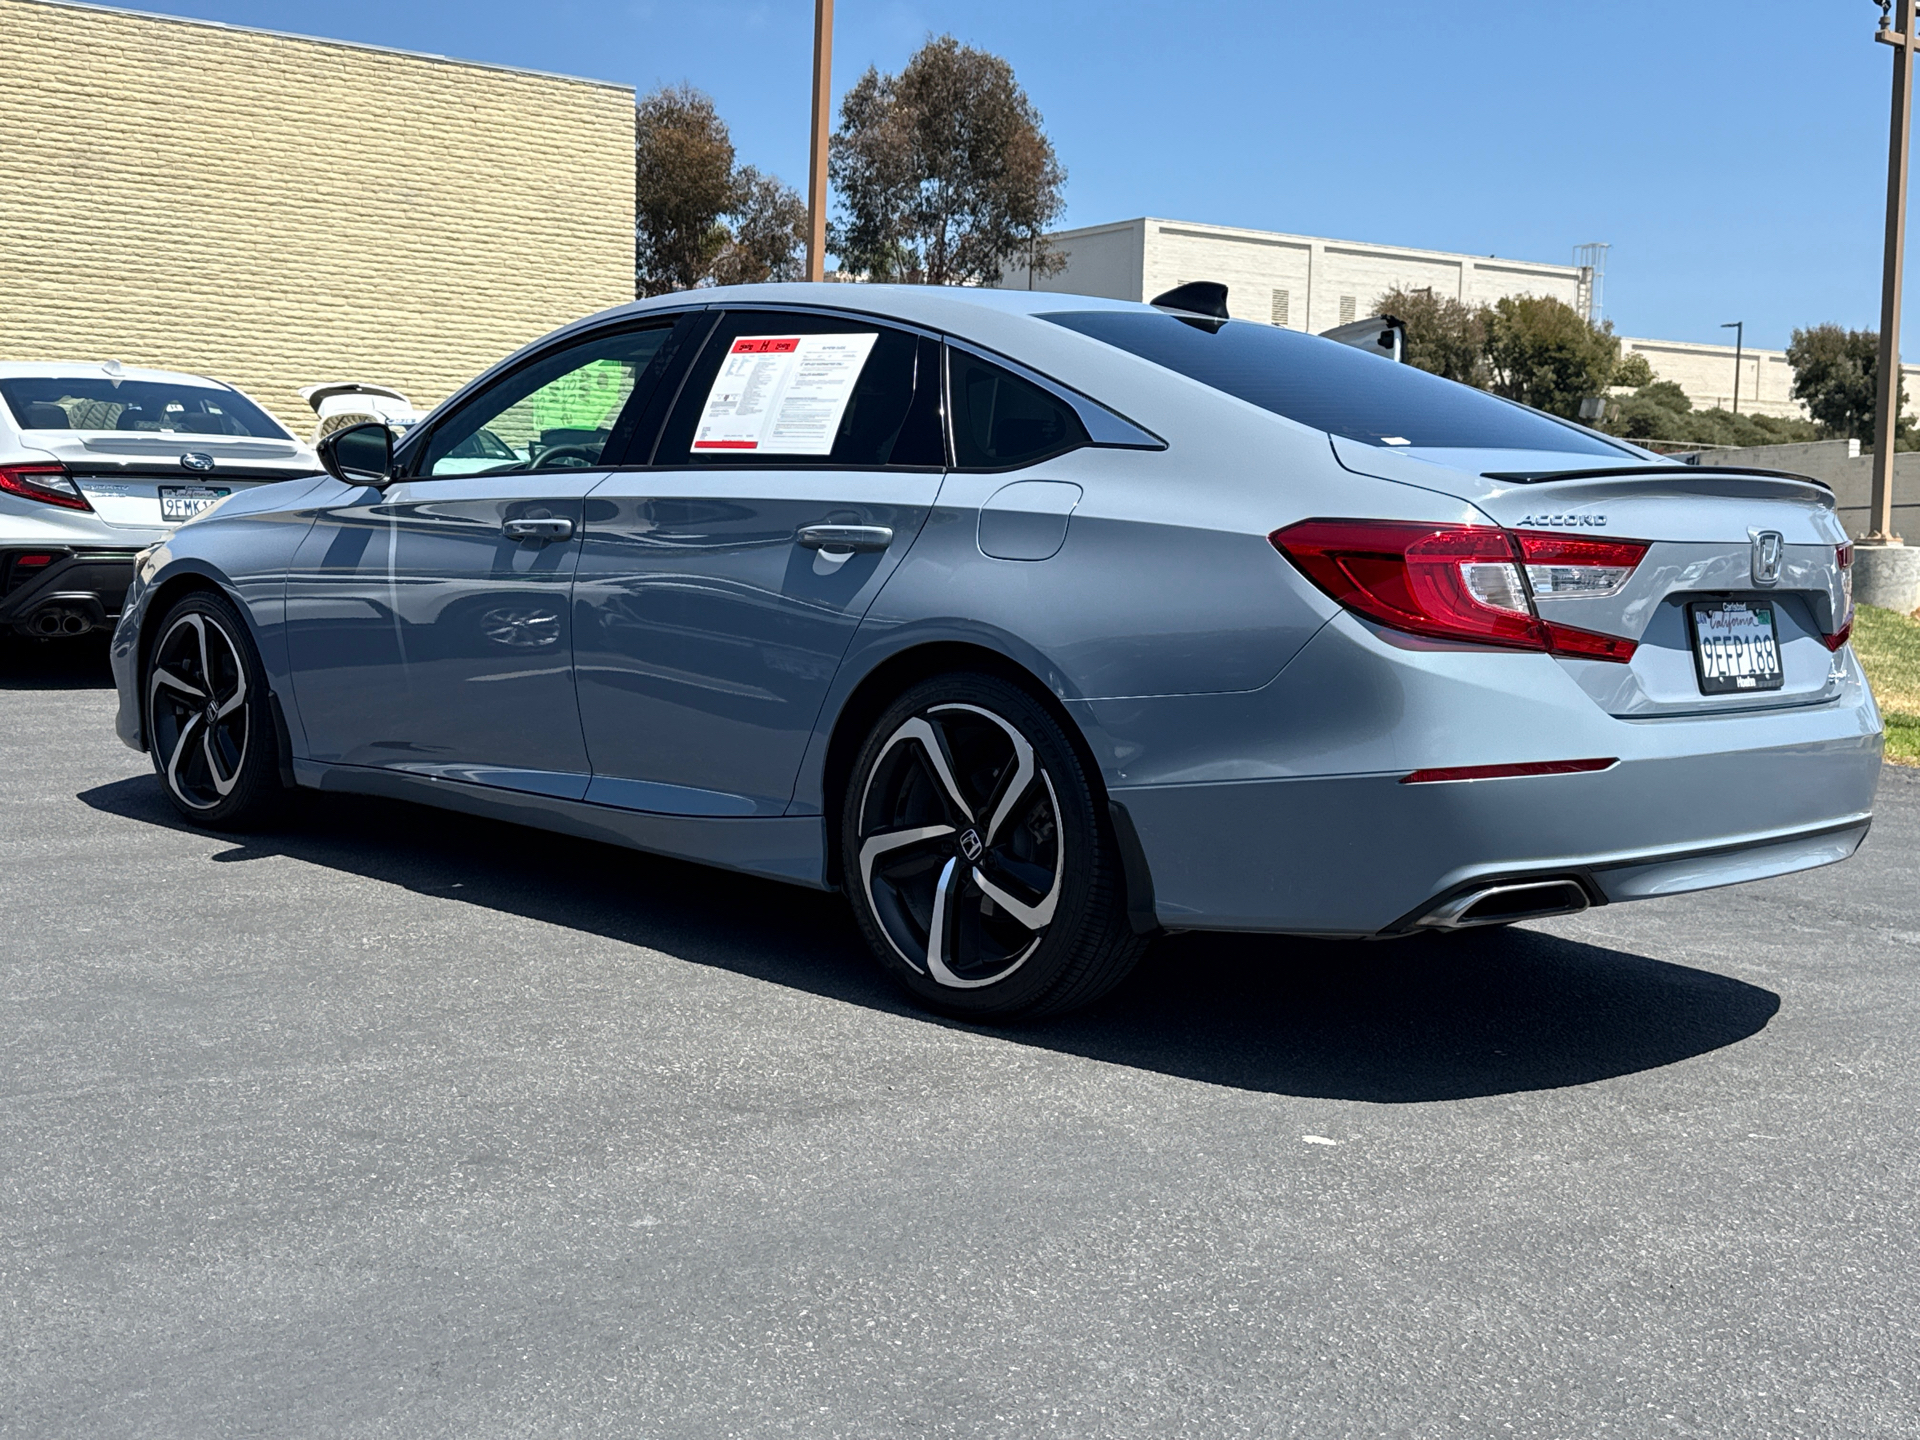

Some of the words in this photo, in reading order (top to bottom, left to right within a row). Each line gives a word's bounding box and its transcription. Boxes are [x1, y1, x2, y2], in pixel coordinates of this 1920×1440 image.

[1516, 515, 1608, 527] ACCORD
[1710, 611, 1759, 634] California
[1703, 634, 1775, 677] 9EFP188
